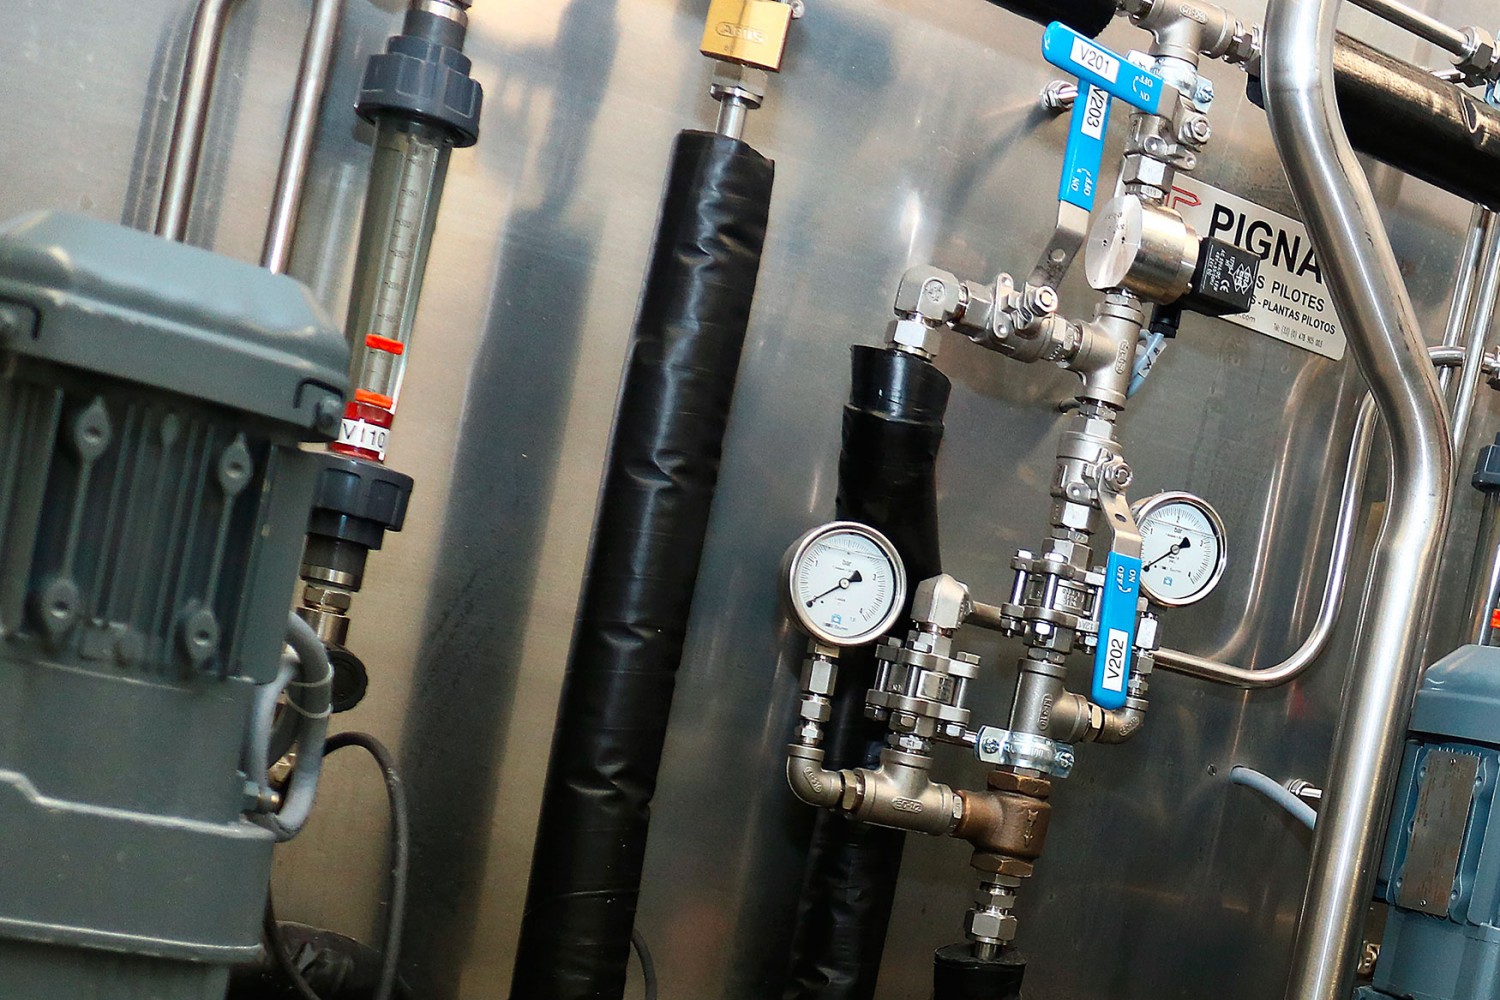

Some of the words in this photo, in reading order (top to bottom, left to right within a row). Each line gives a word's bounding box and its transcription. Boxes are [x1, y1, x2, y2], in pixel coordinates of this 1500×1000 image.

[1080, 43, 1111, 75] V201
[1086, 86, 1105, 128] V203
[1271, 280, 1326, 313] PILOTES
[1262, 299, 1300, 323] PLANTAS
[1301, 314, 1336, 335] PILOTOS
[1128, 568, 1137, 583] ON
[1107, 637, 1125, 680] V202
